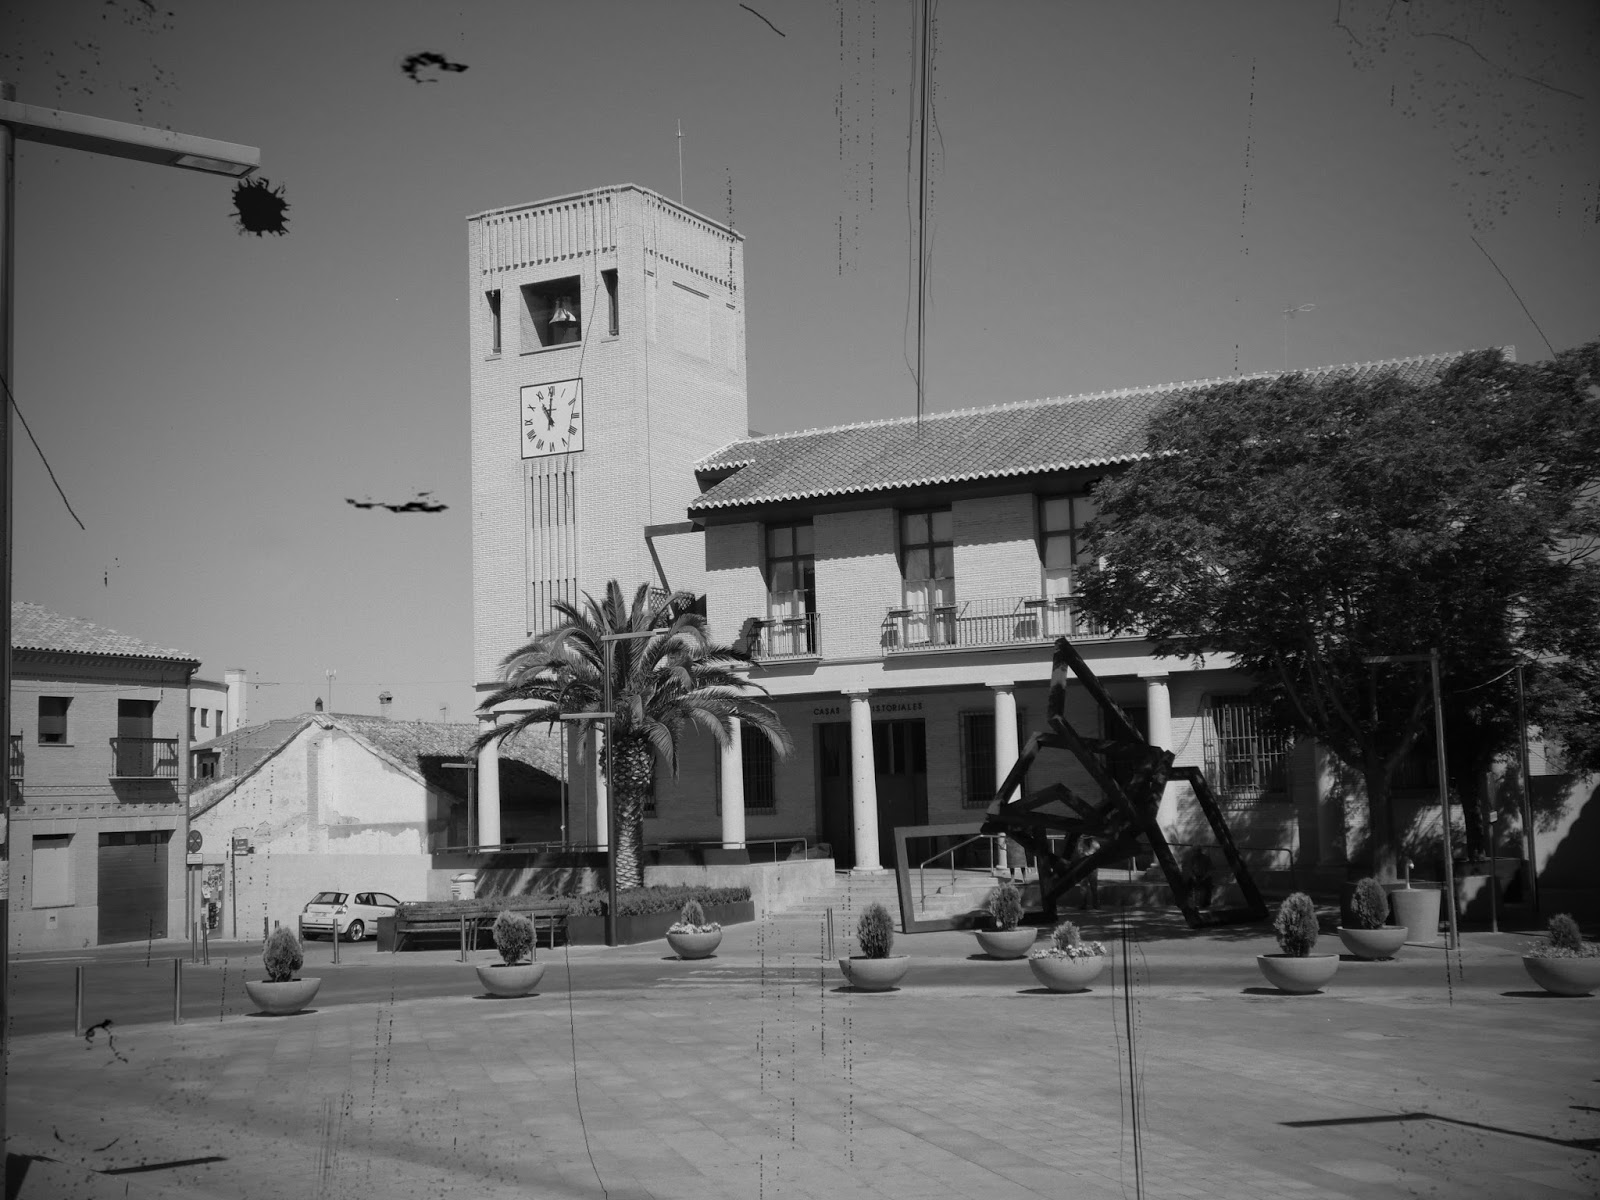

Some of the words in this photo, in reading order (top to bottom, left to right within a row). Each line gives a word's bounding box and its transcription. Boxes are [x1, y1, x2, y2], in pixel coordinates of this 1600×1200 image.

[527, 404, 536, 412] X
[561, 437, 568, 447] V
[813, 707, 840, 716] CASAS
[872, 702, 923, 712] ISTORIALES
